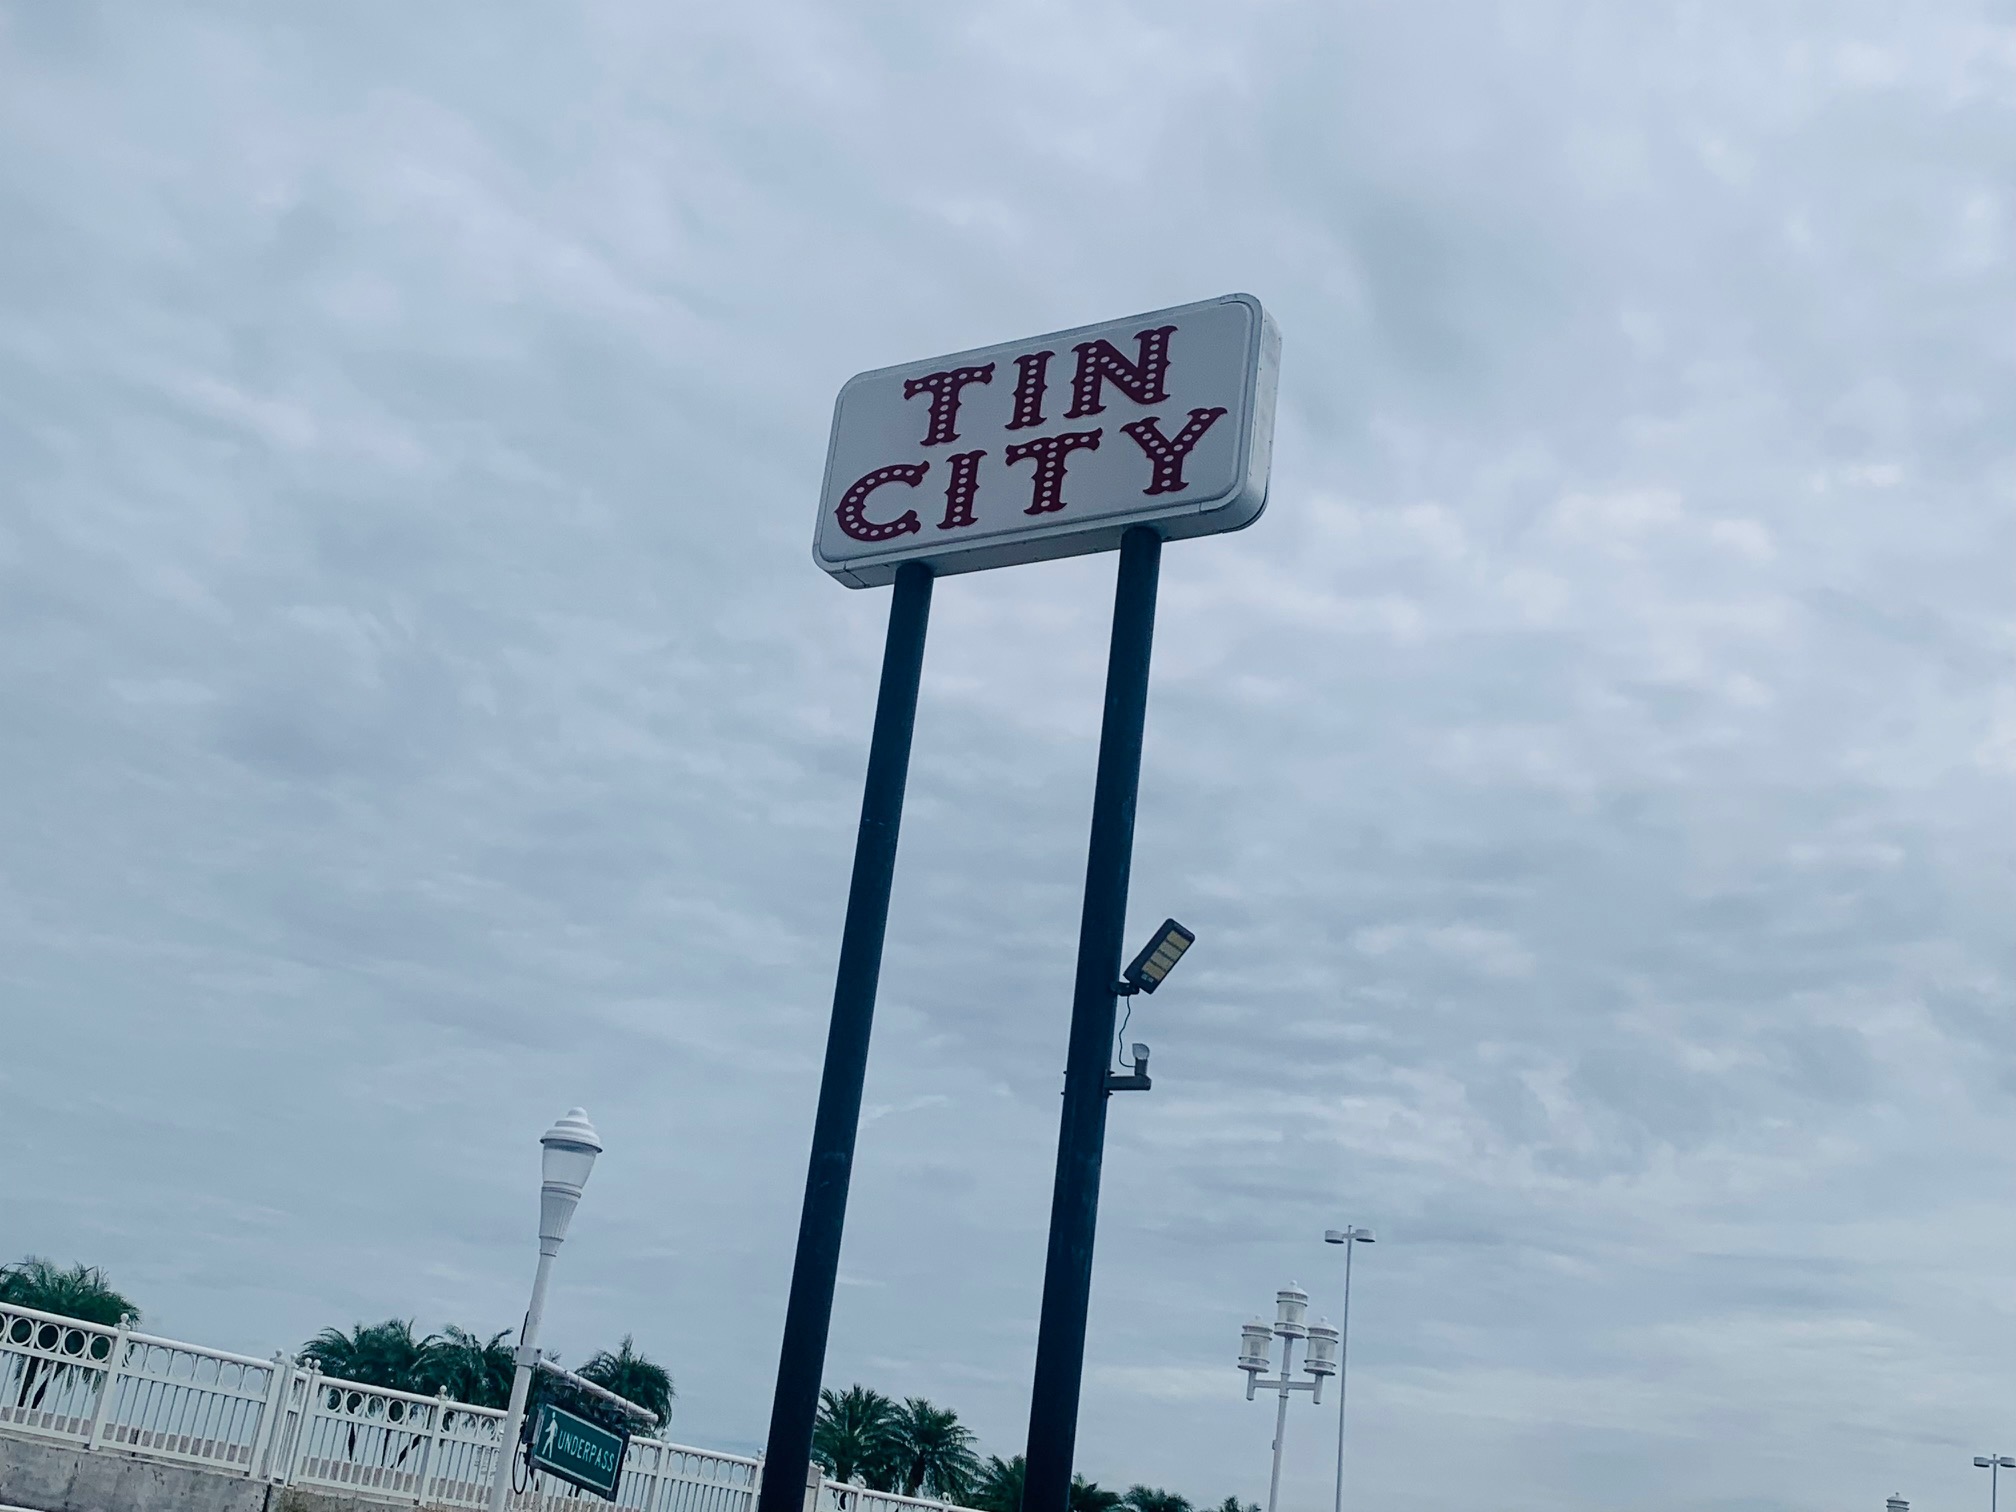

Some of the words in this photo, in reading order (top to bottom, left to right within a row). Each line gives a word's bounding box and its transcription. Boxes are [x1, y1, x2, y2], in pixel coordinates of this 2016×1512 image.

[903, 325, 1178, 446] TIN
[834, 407, 1228, 542] CITY
[557, 1429, 615, 1473] UNDERPASS
